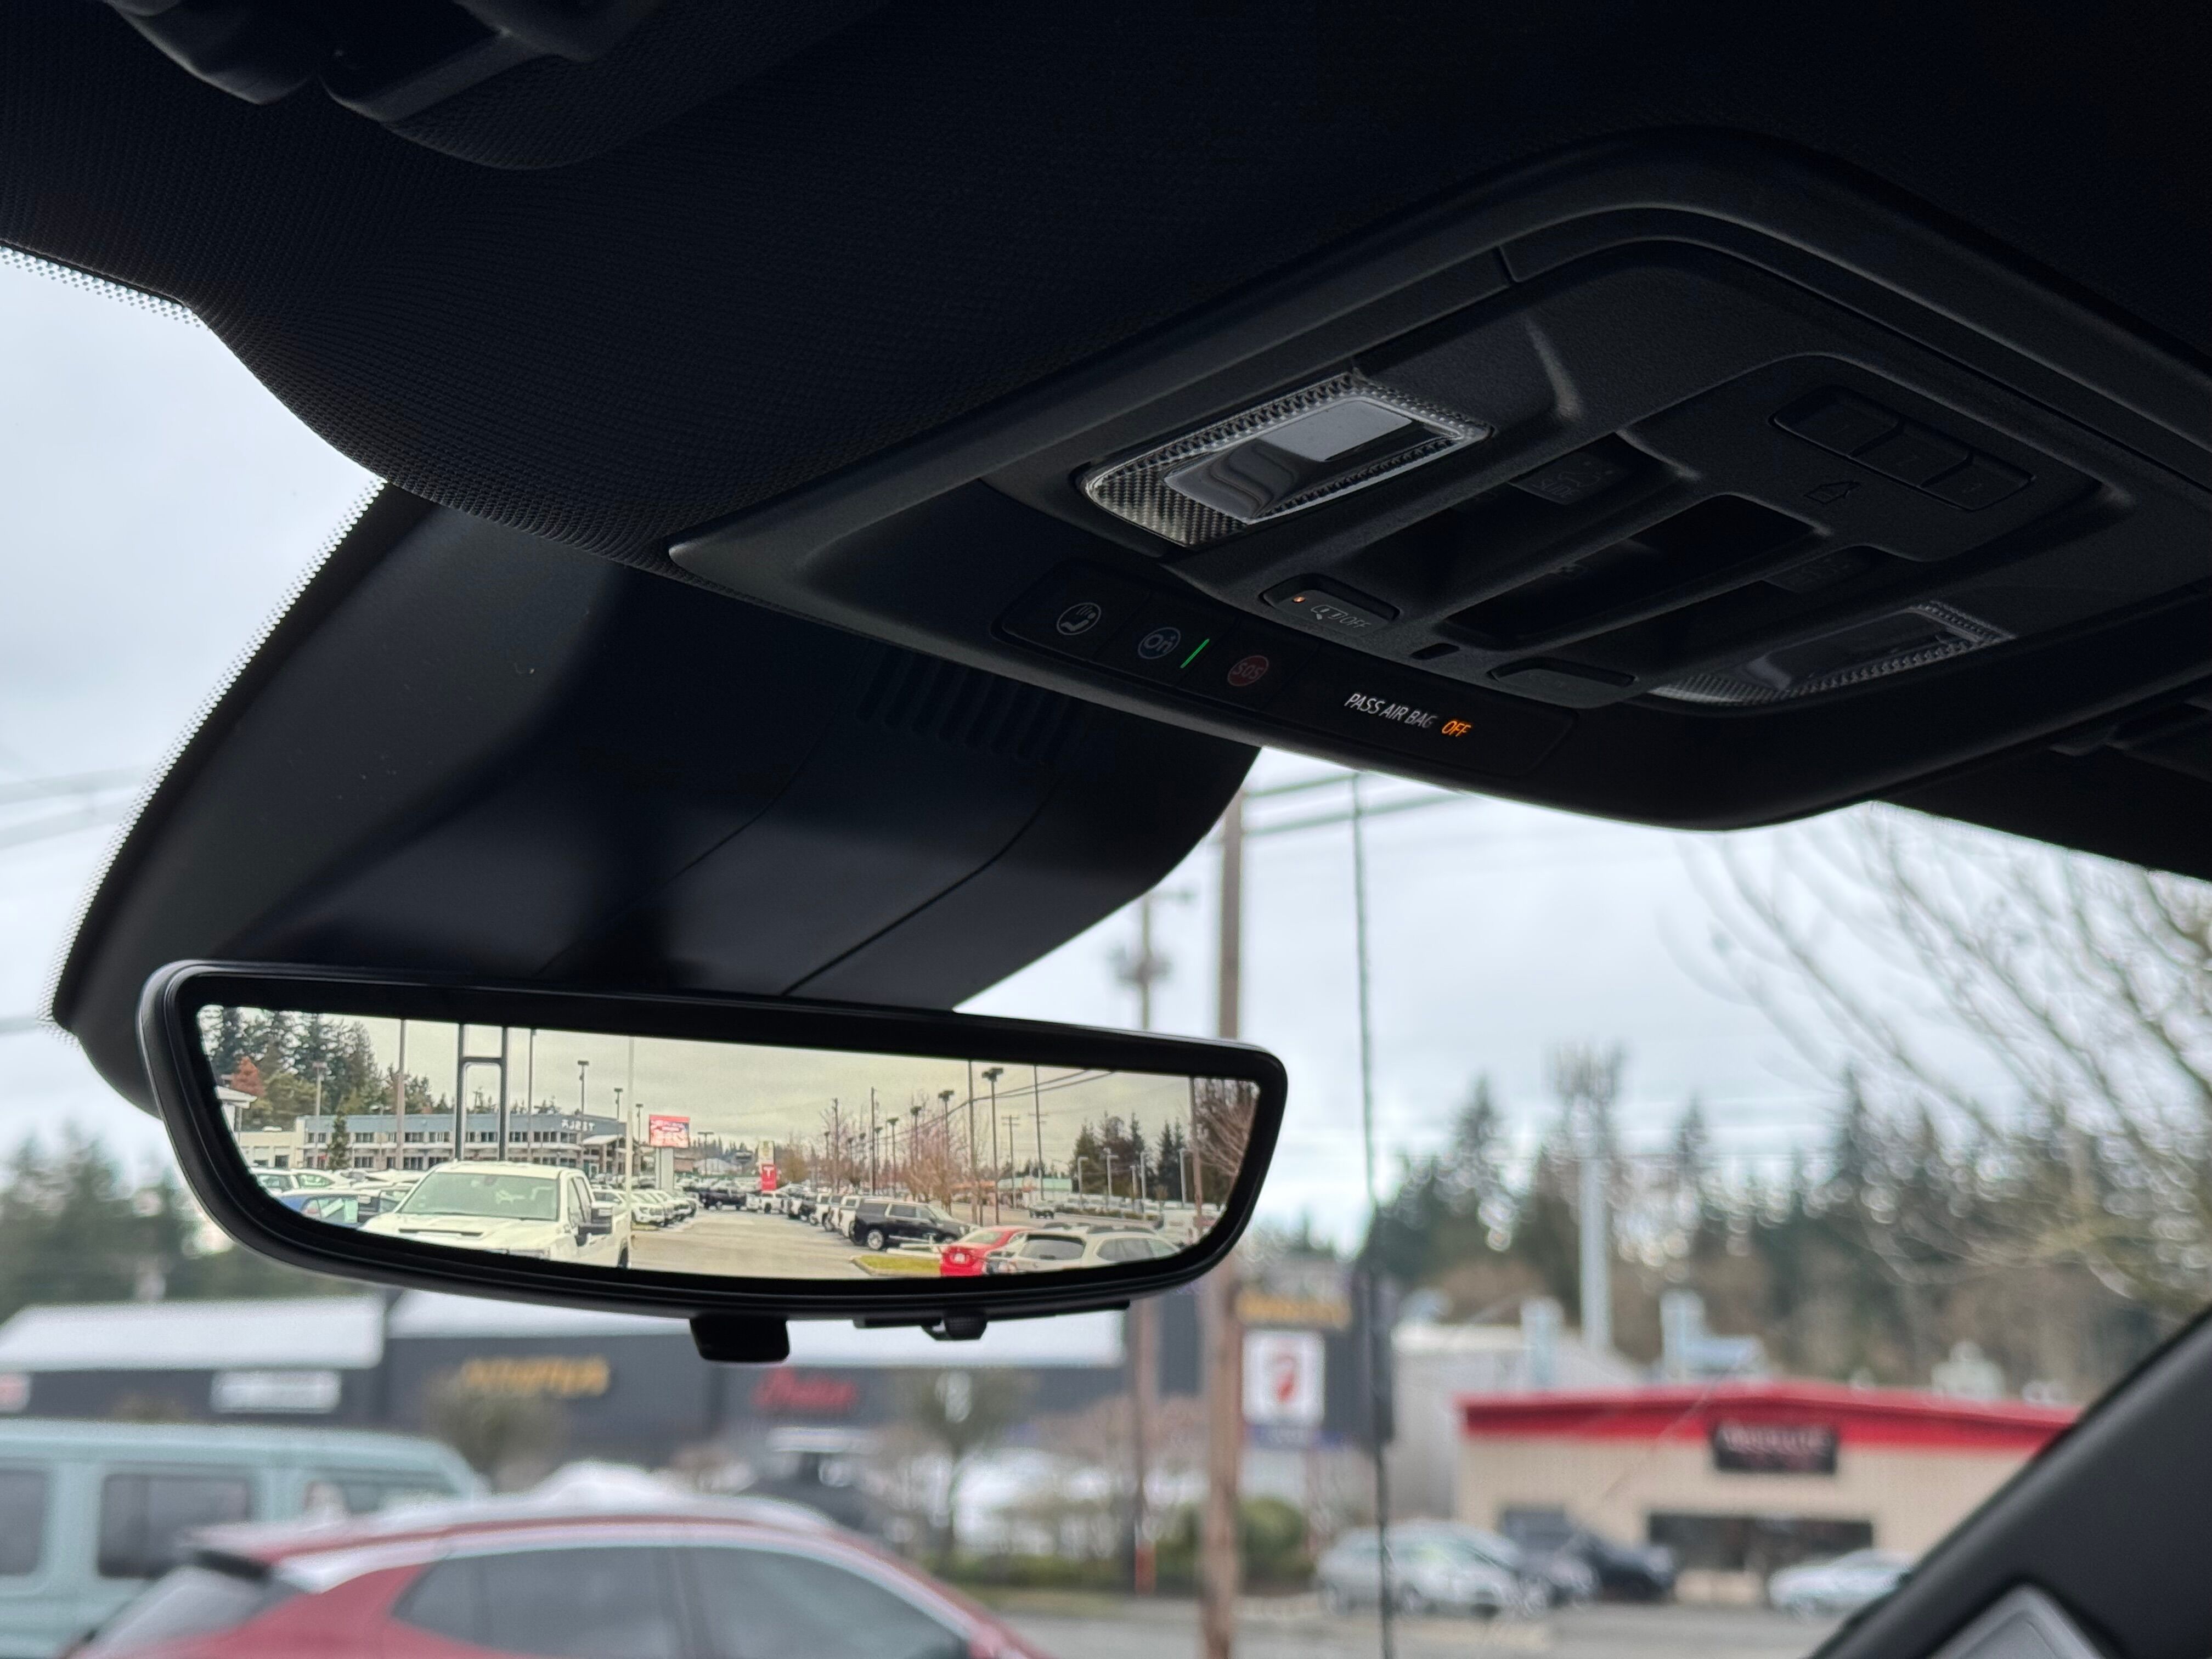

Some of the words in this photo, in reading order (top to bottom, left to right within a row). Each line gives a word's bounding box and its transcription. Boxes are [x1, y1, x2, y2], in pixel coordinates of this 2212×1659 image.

[1339, 617, 1372, 628] OFF
[1143, 634, 1172, 653] On
[1234, 662, 1263, 680] SOS
[1344, 693, 1385, 714] PASS
[1380, 703, 1409, 721] AIR
[1405, 710, 1438, 729] BAG
[1441, 720, 1472, 737] OFF
